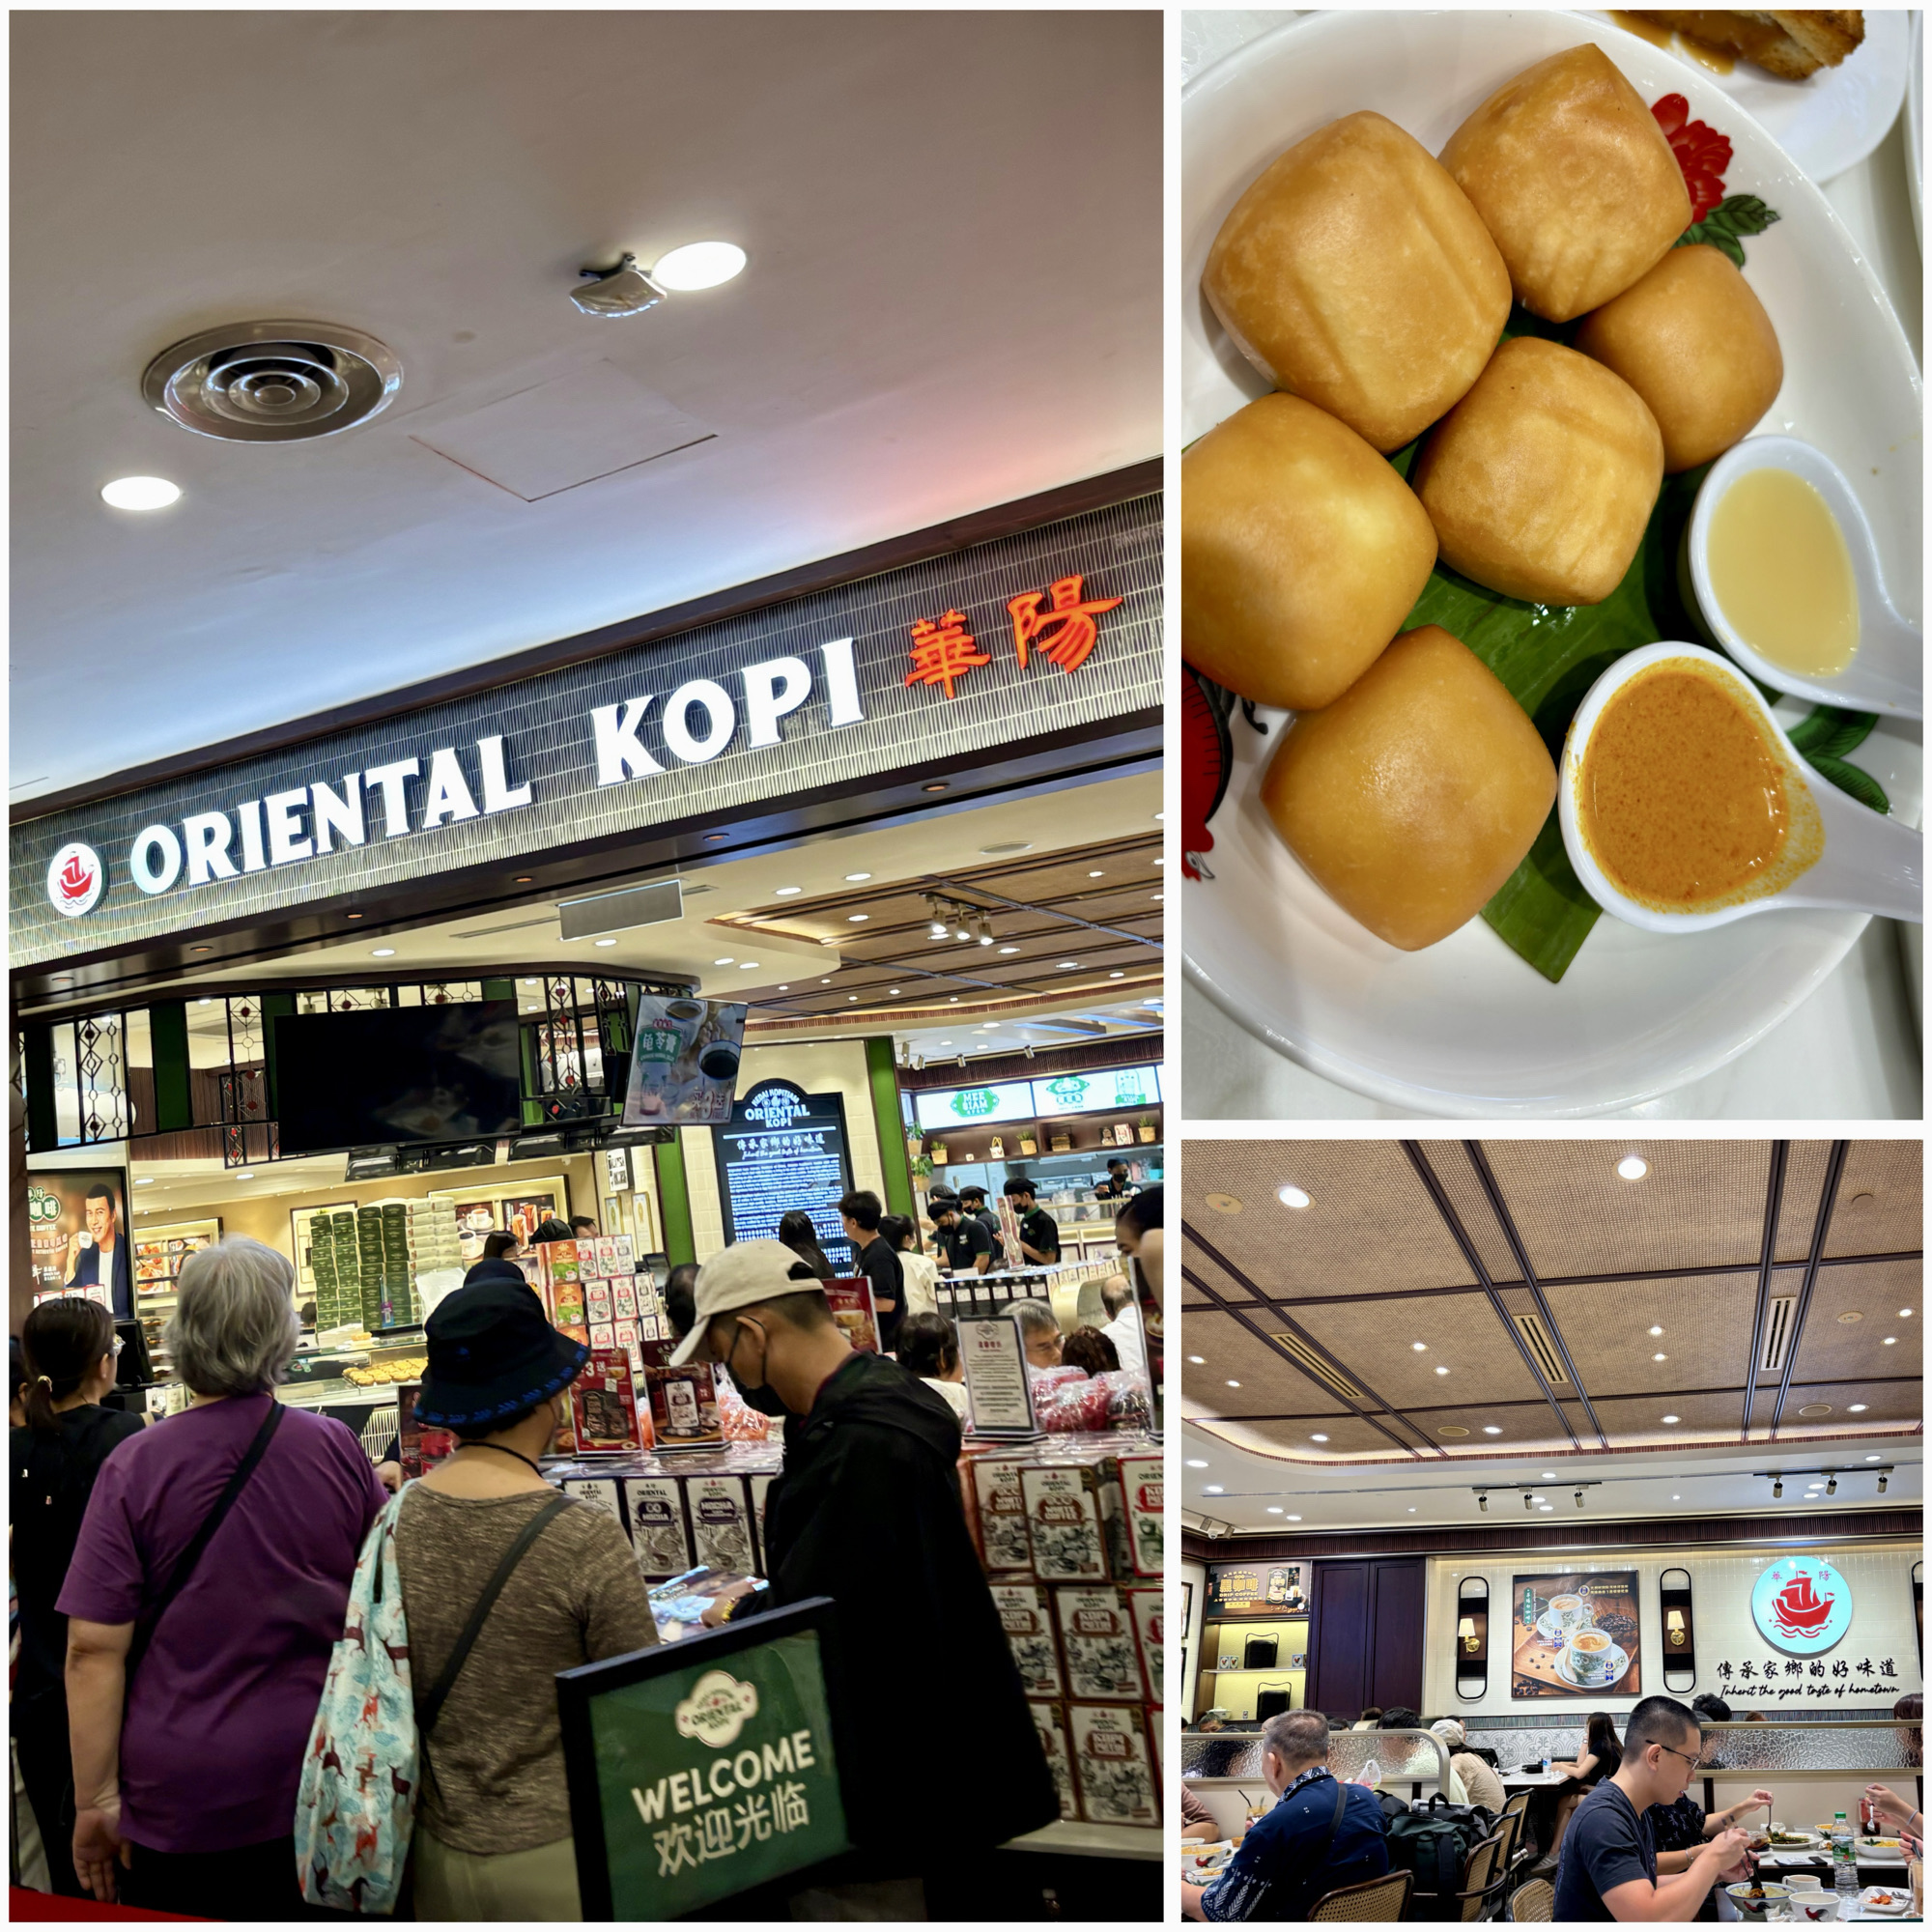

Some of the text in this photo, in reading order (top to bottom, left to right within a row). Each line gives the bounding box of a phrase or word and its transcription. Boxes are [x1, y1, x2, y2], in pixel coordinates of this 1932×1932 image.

[905, 574, 1123, 699] 華陽
[130, 637, 866, 895] ORIENTAL KOPI
[963, 1092, 985, 1101] MEE
[744, 1104, 810, 1121] ORIENTAL
[765, 1117, 792, 1128] KOPI
[1219, 1577, 1259, 1592] 黑咖啡
[1717, 1658, 1898, 1680] 傳承家鄉的好味道
[1719, 1683, 1900, 1700] Inherit the good taste of hometown
[631, 1730, 815, 1824] WELCOME
[652, 1780, 810, 1878] 欢迎光临
